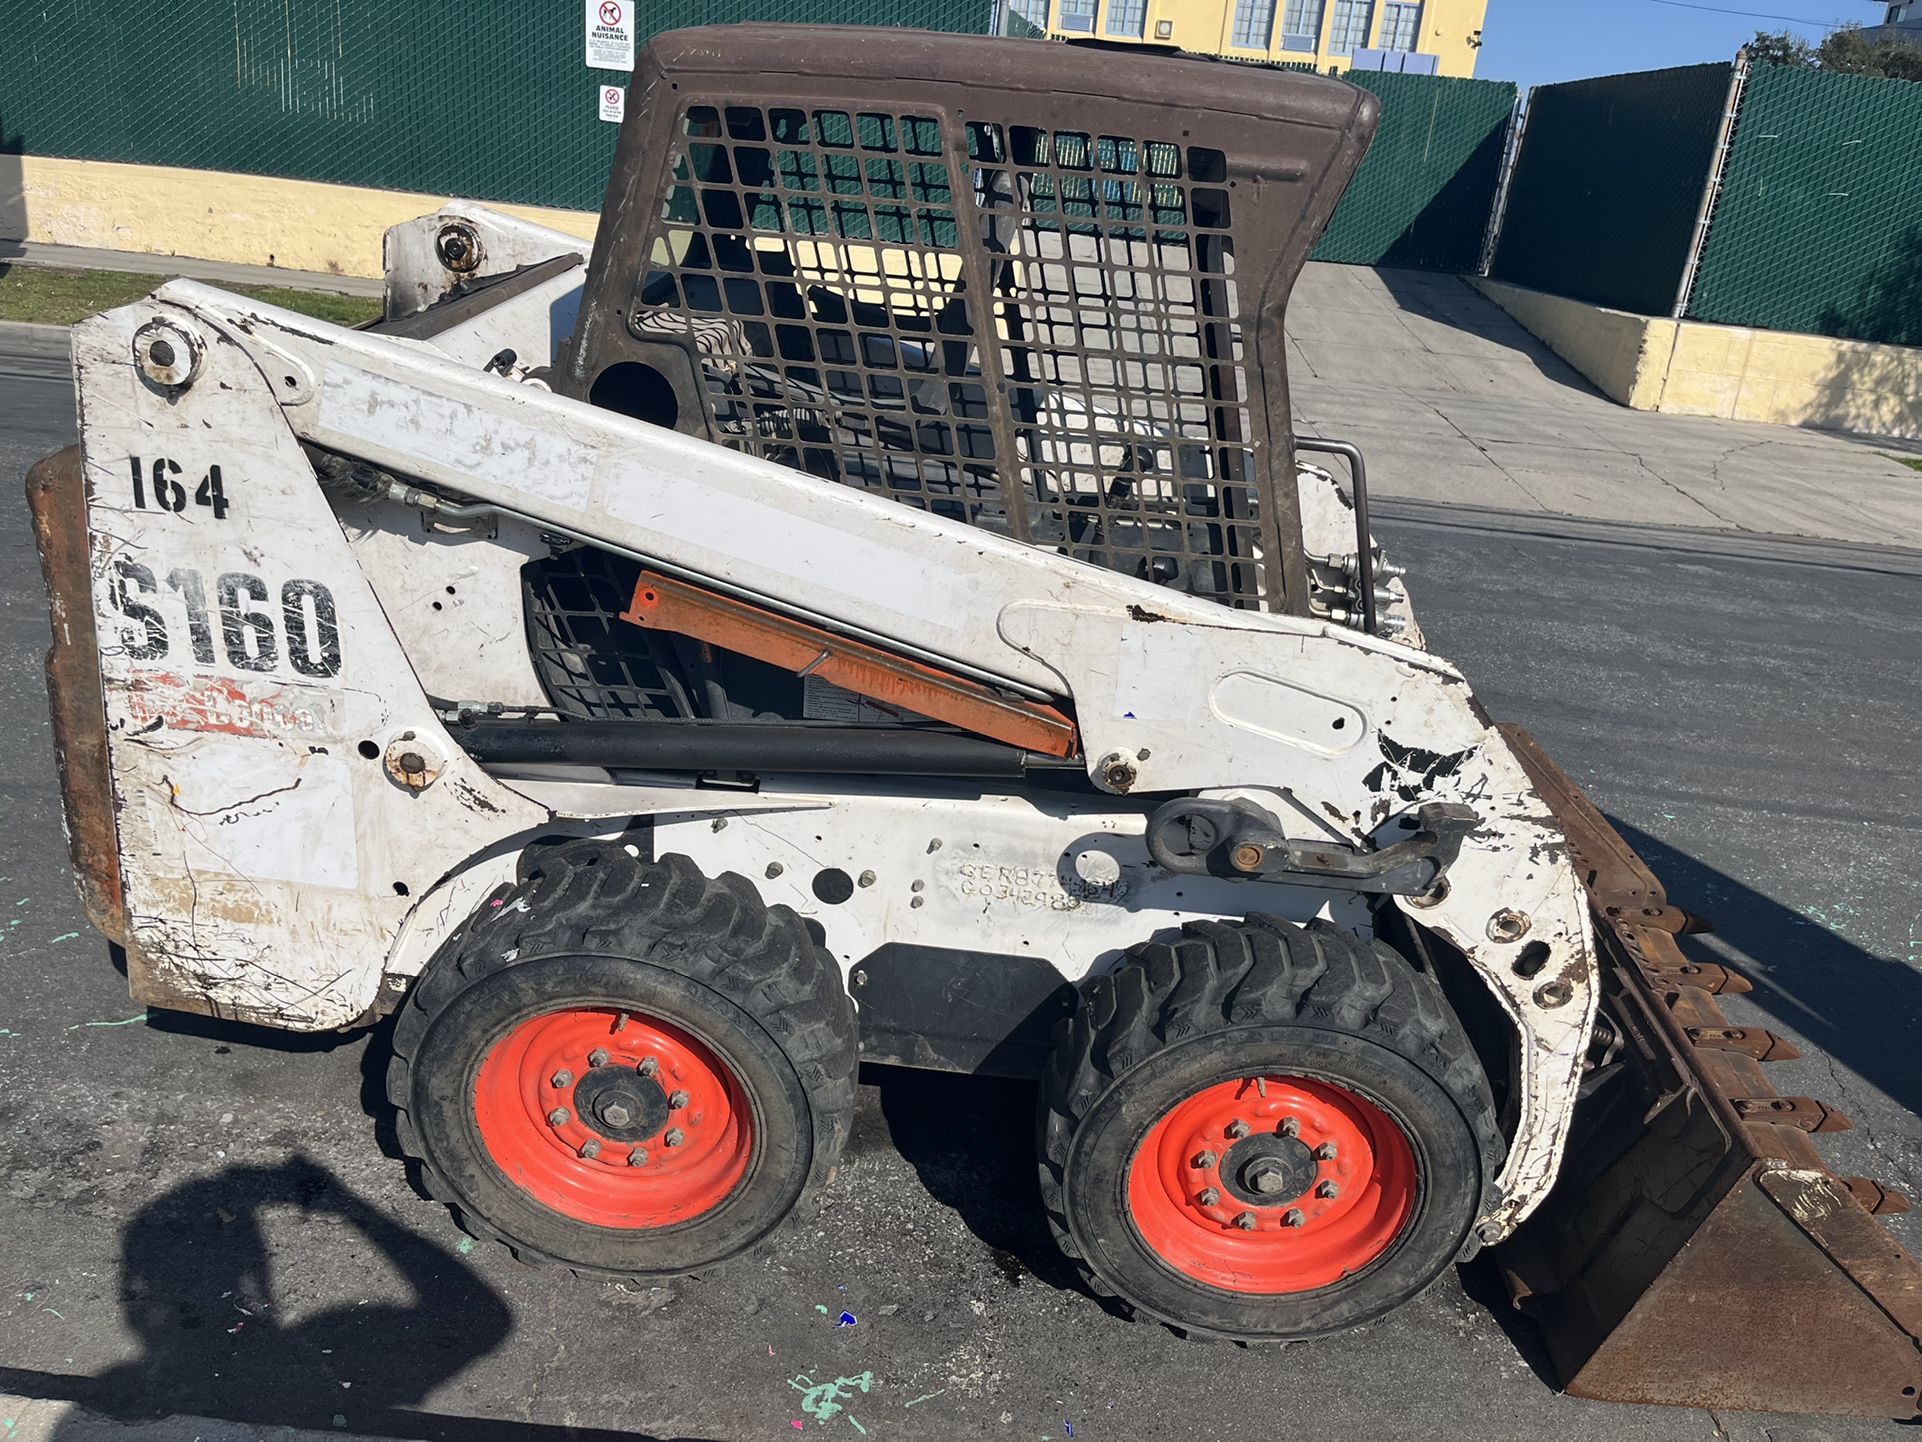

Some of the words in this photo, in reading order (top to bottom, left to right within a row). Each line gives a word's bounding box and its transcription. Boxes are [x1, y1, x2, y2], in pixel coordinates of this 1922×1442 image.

[591, 32, 628, 41] NUISANCE
[596, 25, 625, 33] ANIMAL
[129, 455, 229, 520] 164
[109, 560, 342, 678] S160
